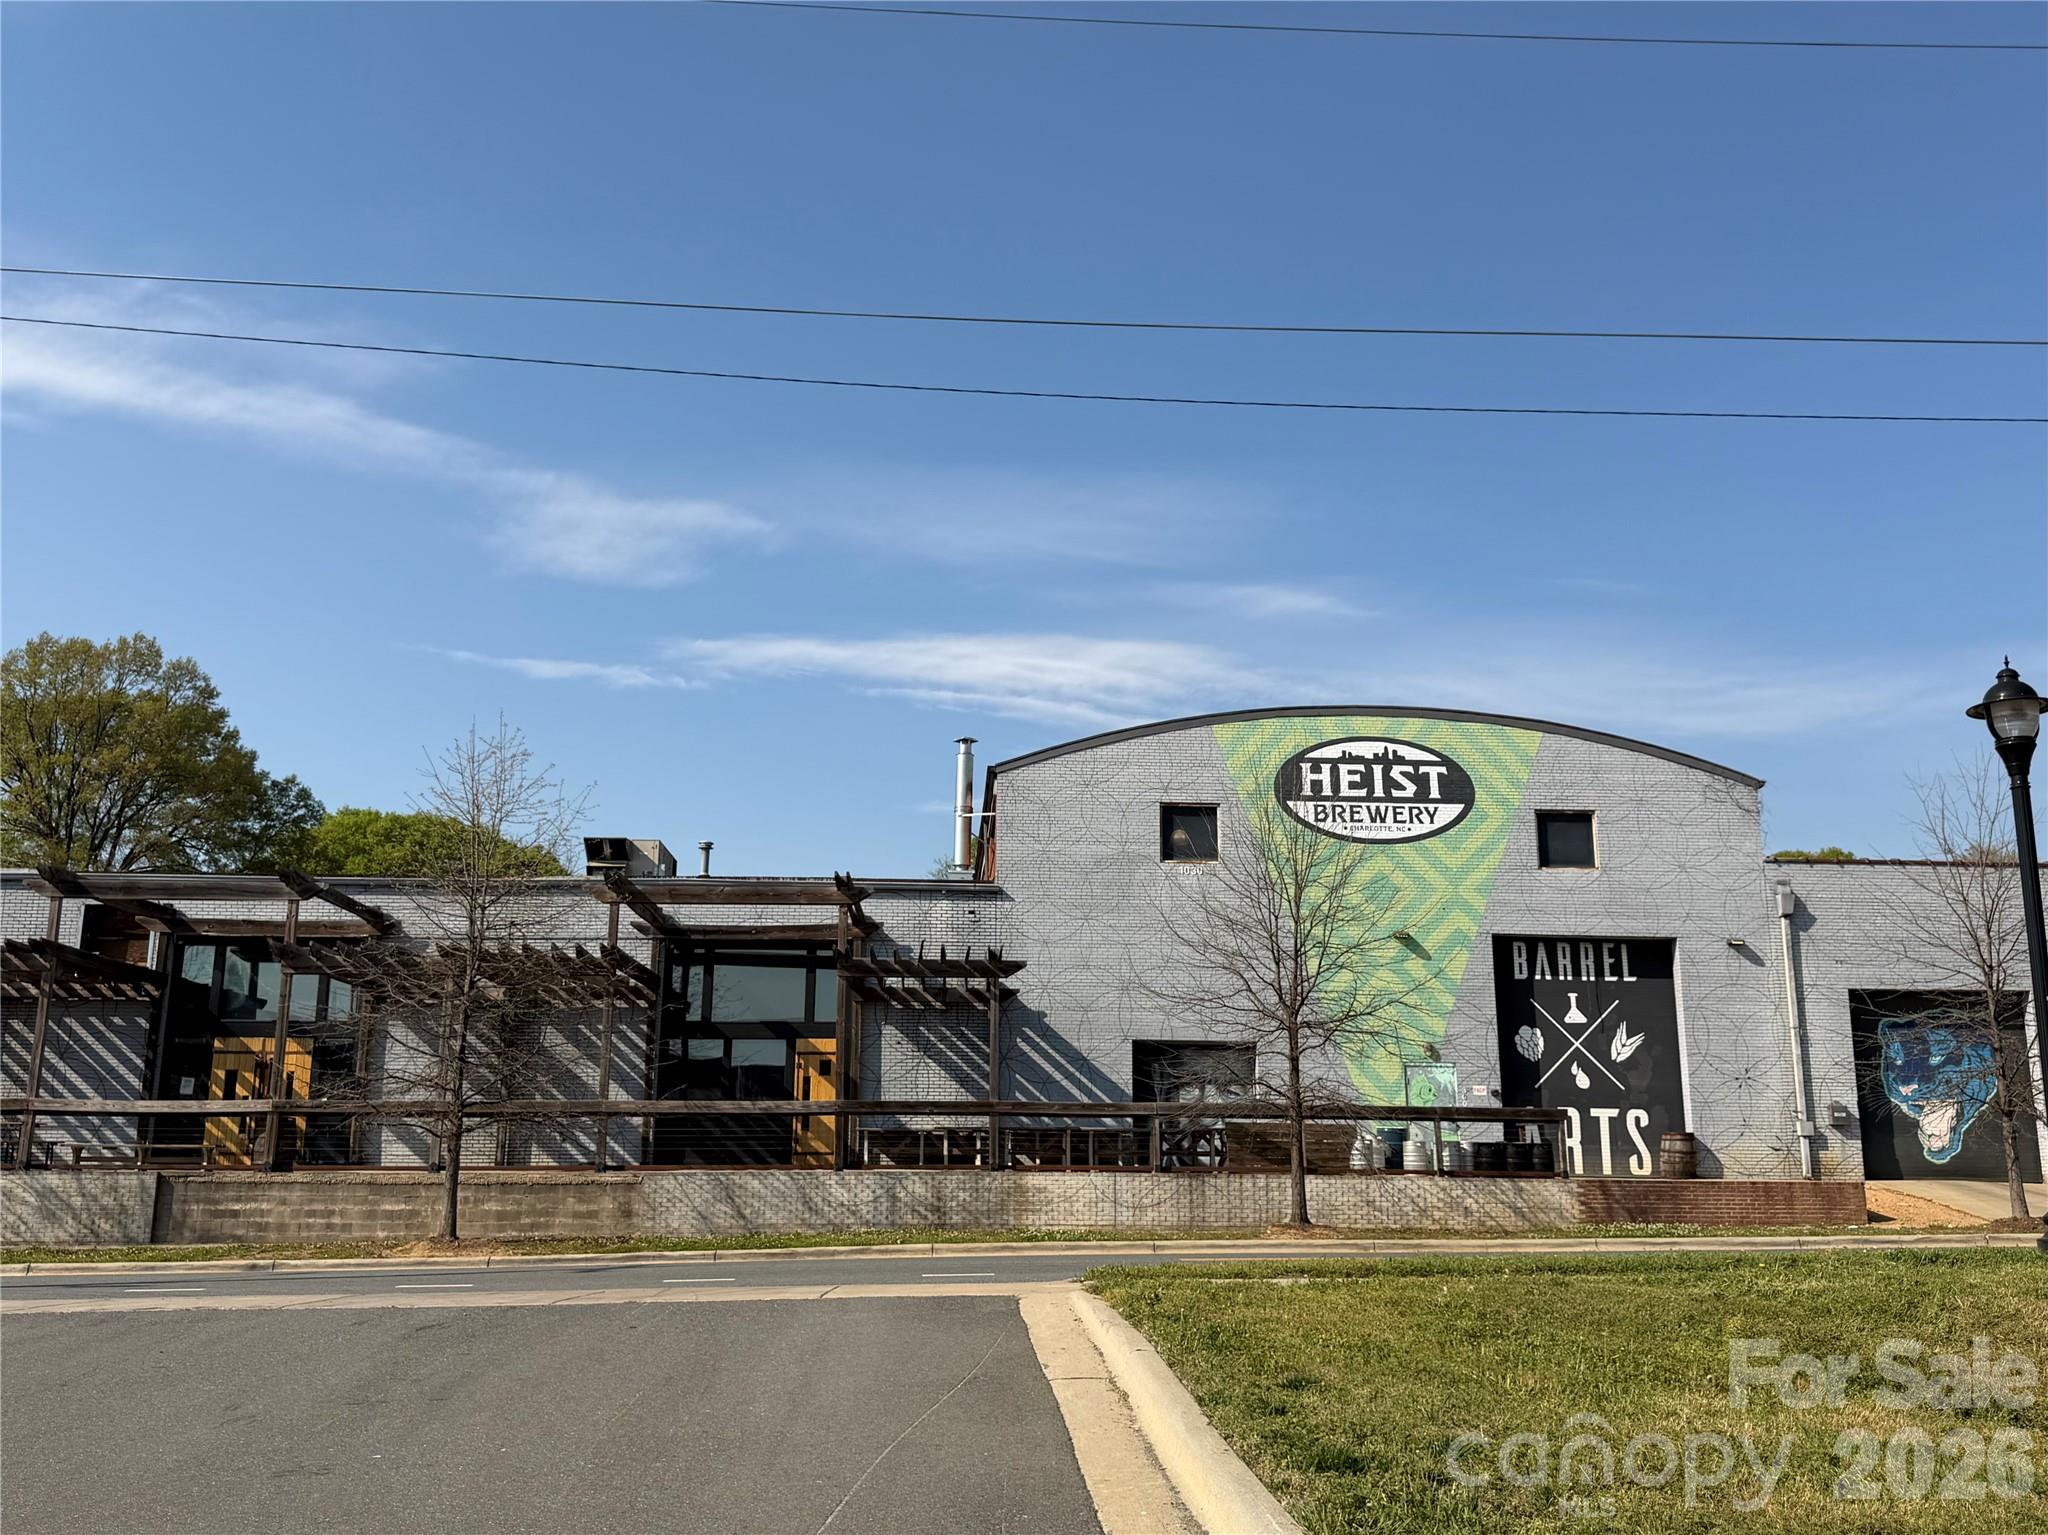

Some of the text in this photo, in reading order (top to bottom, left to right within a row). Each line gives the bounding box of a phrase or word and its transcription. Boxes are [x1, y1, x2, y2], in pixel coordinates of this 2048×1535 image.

[1299, 762, 1448, 799] HEIST
[1313, 804, 1439, 824] BREWERY
[1179, 866, 1203, 875] 1030
[1512, 941, 1638, 982] BARREL
